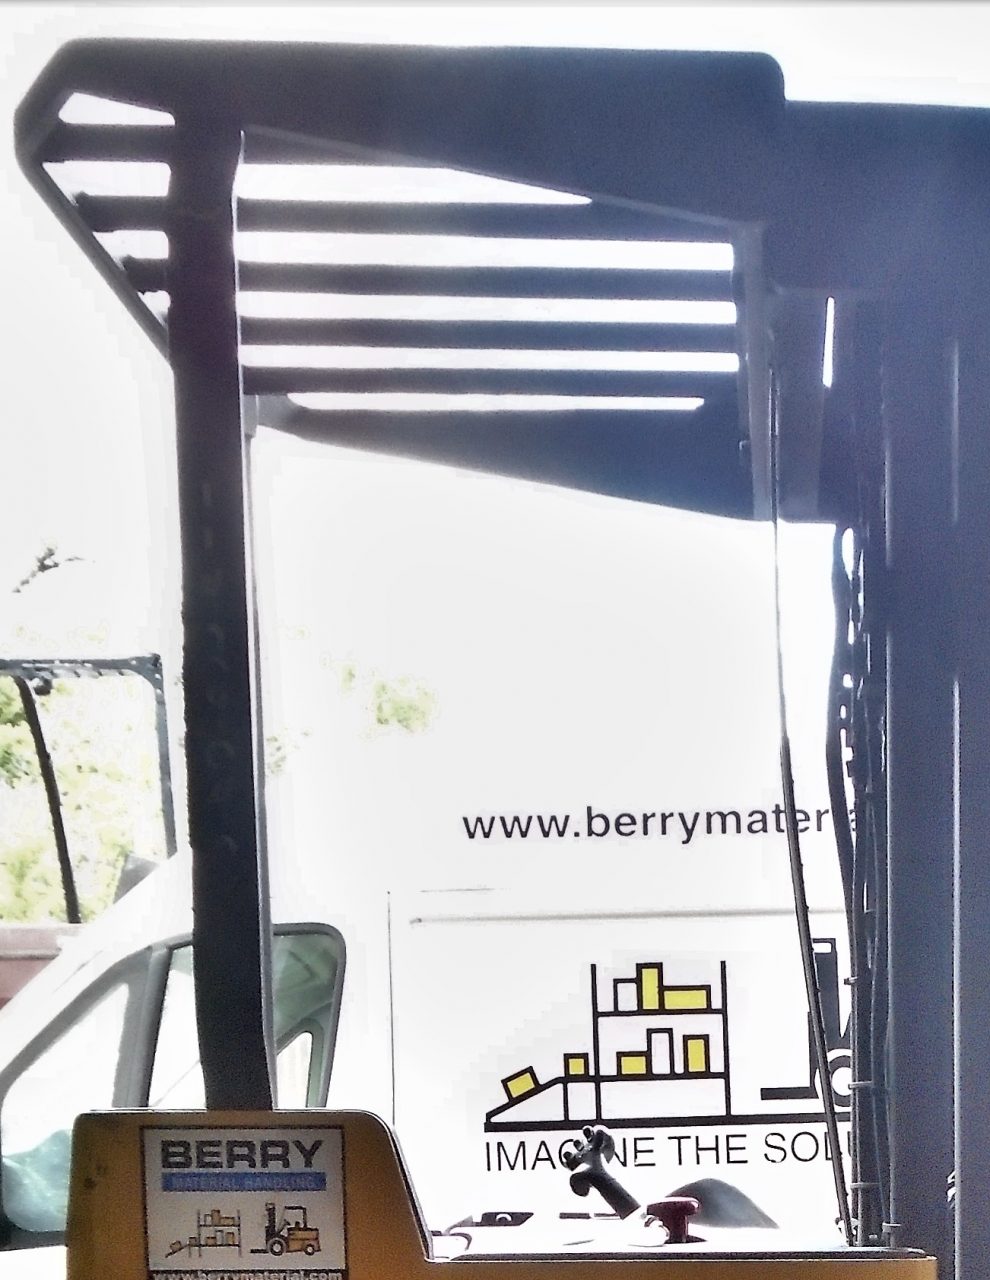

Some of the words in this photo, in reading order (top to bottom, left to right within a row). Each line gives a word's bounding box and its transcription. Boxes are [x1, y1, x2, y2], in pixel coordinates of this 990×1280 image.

[463, 805, 857, 844] www.berrymater
[161, 1140, 323, 1168] BERRY
[486, 1137, 656, 1171] IMANE
[667, 1134, 748, 1167] THE
[172, 1177, 240, 1188] MATERIAL
[244, 1176, 316, 1188] HANDLING
